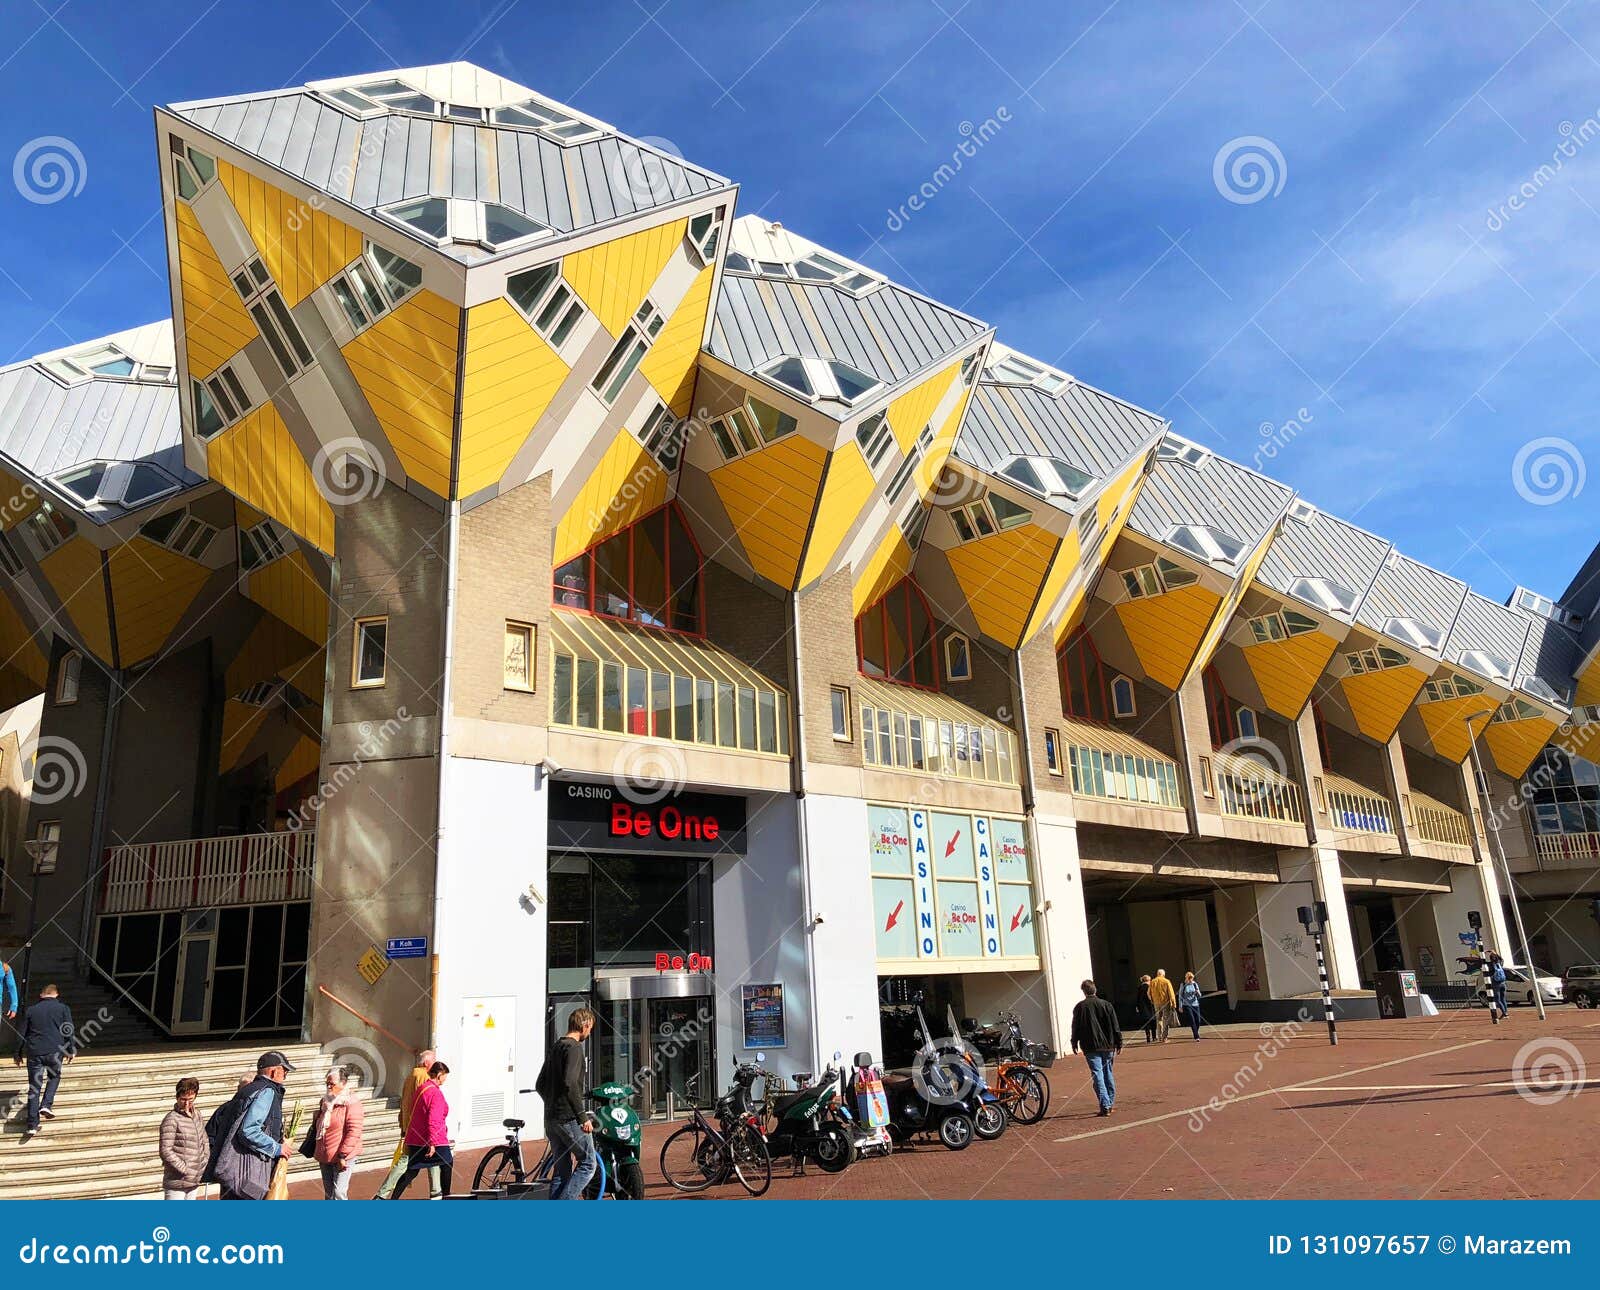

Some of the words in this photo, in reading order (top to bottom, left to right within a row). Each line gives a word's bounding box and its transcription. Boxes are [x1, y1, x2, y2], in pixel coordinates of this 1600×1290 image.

[568, 785, 612, 800] CASINO
[611, 802, 651, 836] Be
[659, 805, 719, 840] One
[881, 833, 890, 844] Be
[892, 834, 908, 845] One
[1003, 844, 1012, 854] Be
[913, 813, 934, 954] CASINO
[976, 820, 997, 953] CASINO
[952, 912, 960, 922] Be
[962, 912, 976, 923] One
[655, 952, 684, 971] Be
[688, 952, 713, 971] On
